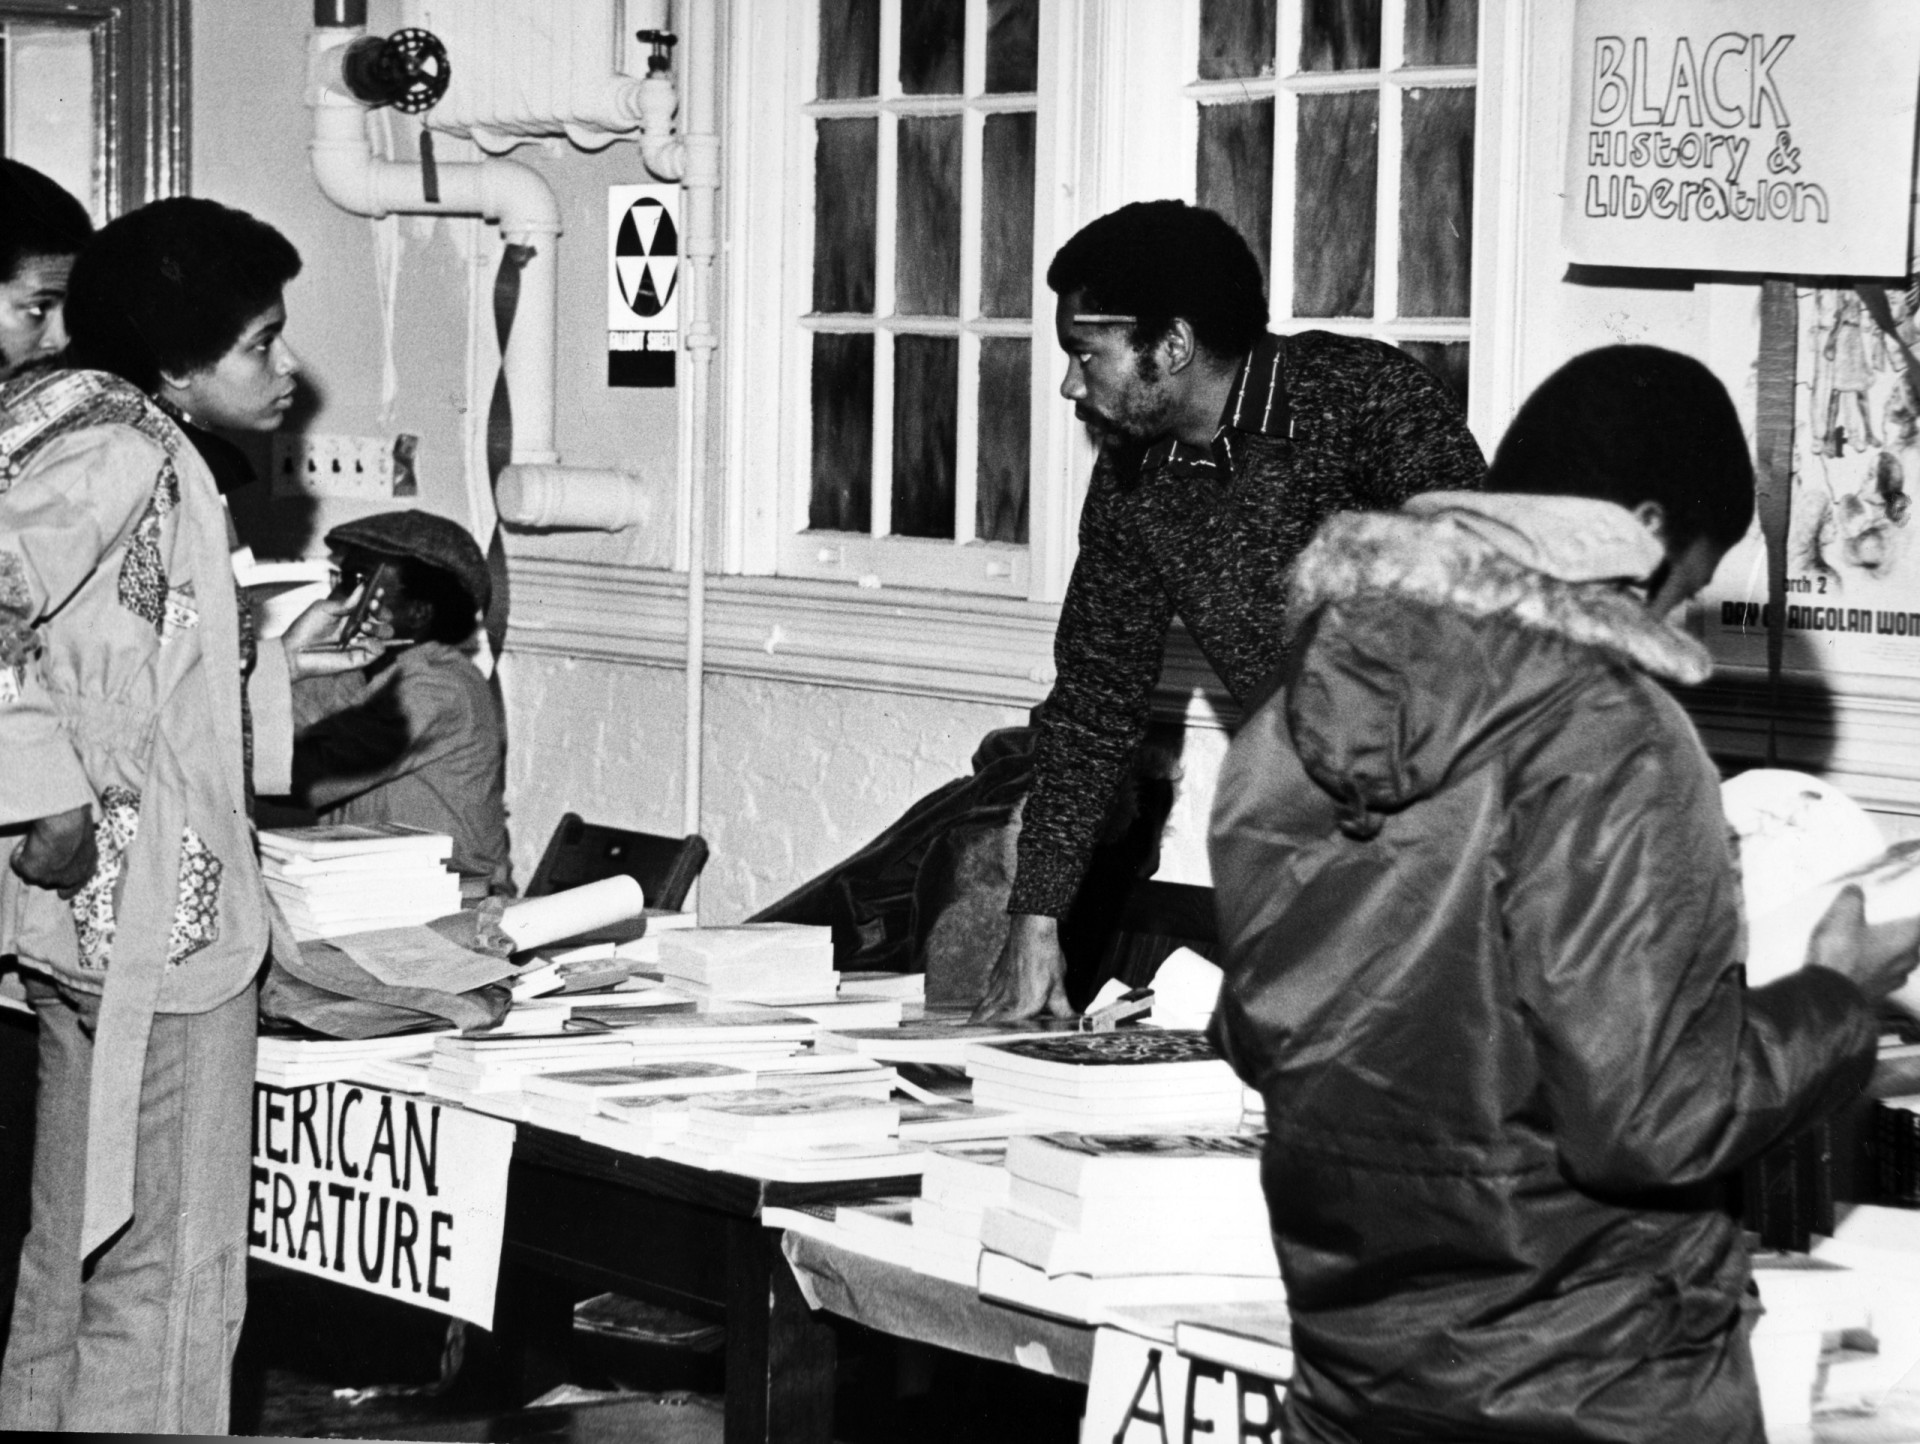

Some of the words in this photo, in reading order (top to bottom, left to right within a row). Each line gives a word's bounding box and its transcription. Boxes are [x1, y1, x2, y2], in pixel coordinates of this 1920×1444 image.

[1591, 32, 1796, 128] BLACK
[1767, 130, 1801, 174] &
[1783, 575, 1812, 593] arch
[1817, 576, 1827, 594] 2
[1787, 604, 1873, 634] ANGOLAN
